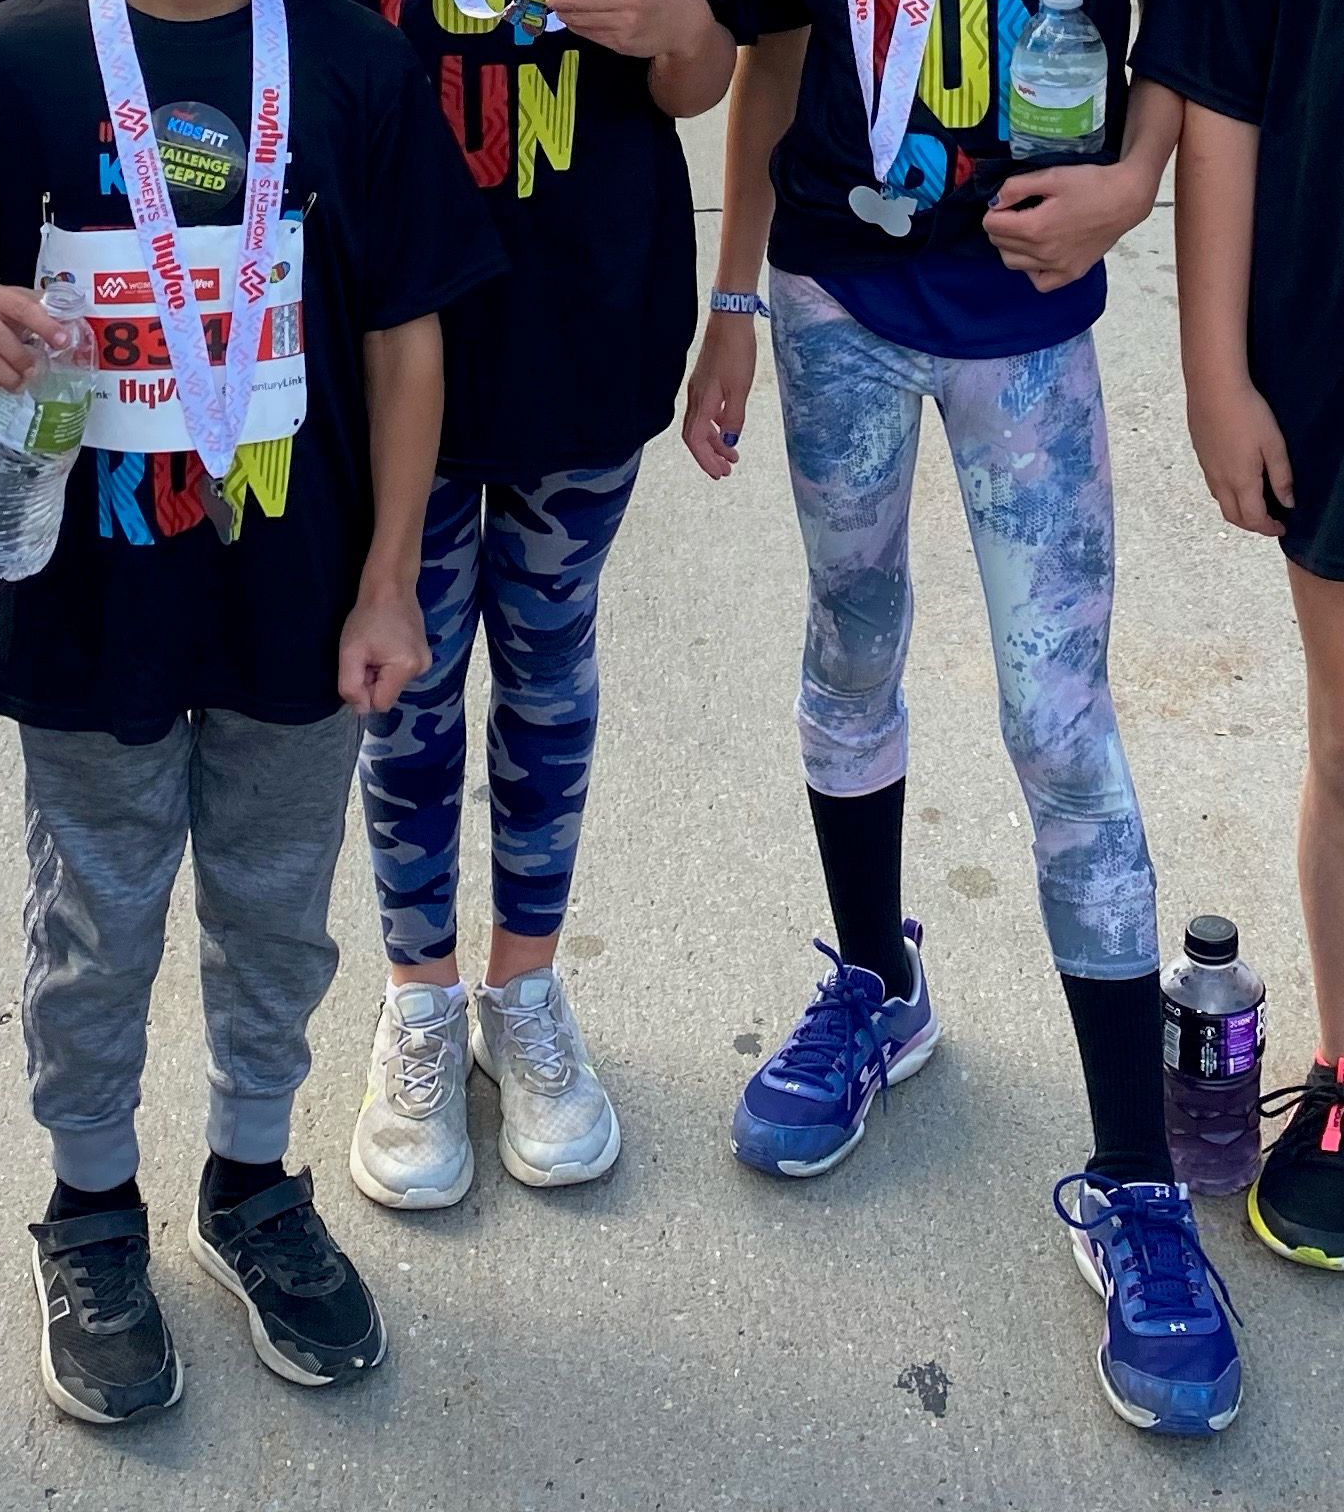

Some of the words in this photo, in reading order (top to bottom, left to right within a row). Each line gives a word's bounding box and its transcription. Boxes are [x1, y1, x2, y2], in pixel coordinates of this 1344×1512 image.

[167, 115, 229, 148] KIDSFIT
[255, 88, 284, 164] HyVee
[441, 50, 579, 198] UN
[134, 151, 160, 222] WOMEN'S
[160, 145, 231, 176] ALLENGE
[163, 163, 227, 191] CEPTED
[252, 179, 271, 250] WOMEN'S
[152, 233, 185, 310] HyVee
[119, 379, 183, 408] HyV
[252, 376, 304, 393] enturyLink
[96, 438, 292, 546] RUN
